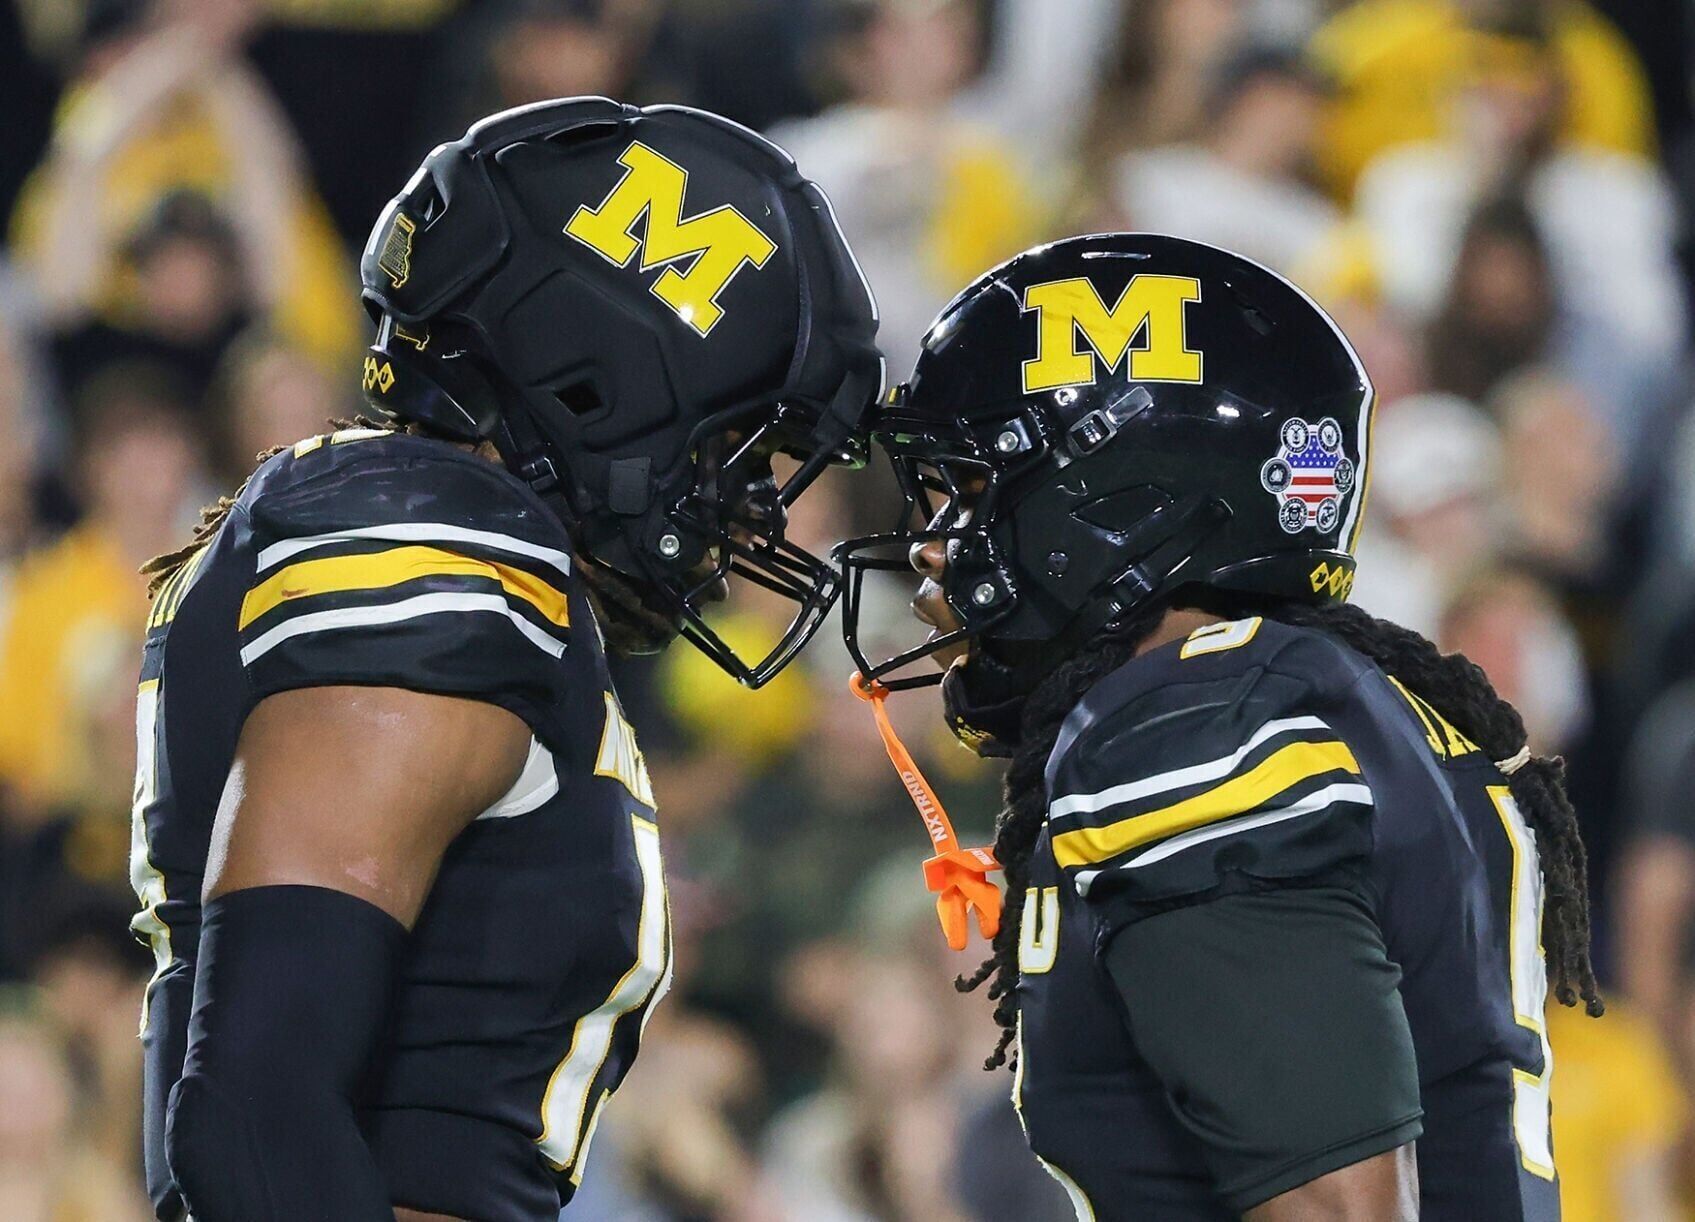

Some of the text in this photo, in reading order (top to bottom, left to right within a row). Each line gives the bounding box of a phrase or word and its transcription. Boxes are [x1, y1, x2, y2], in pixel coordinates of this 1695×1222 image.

[563, 140, 778, 338] M
[1021, 273, 1204, 395] M
[902, 771, 949, 843] NXTRND
